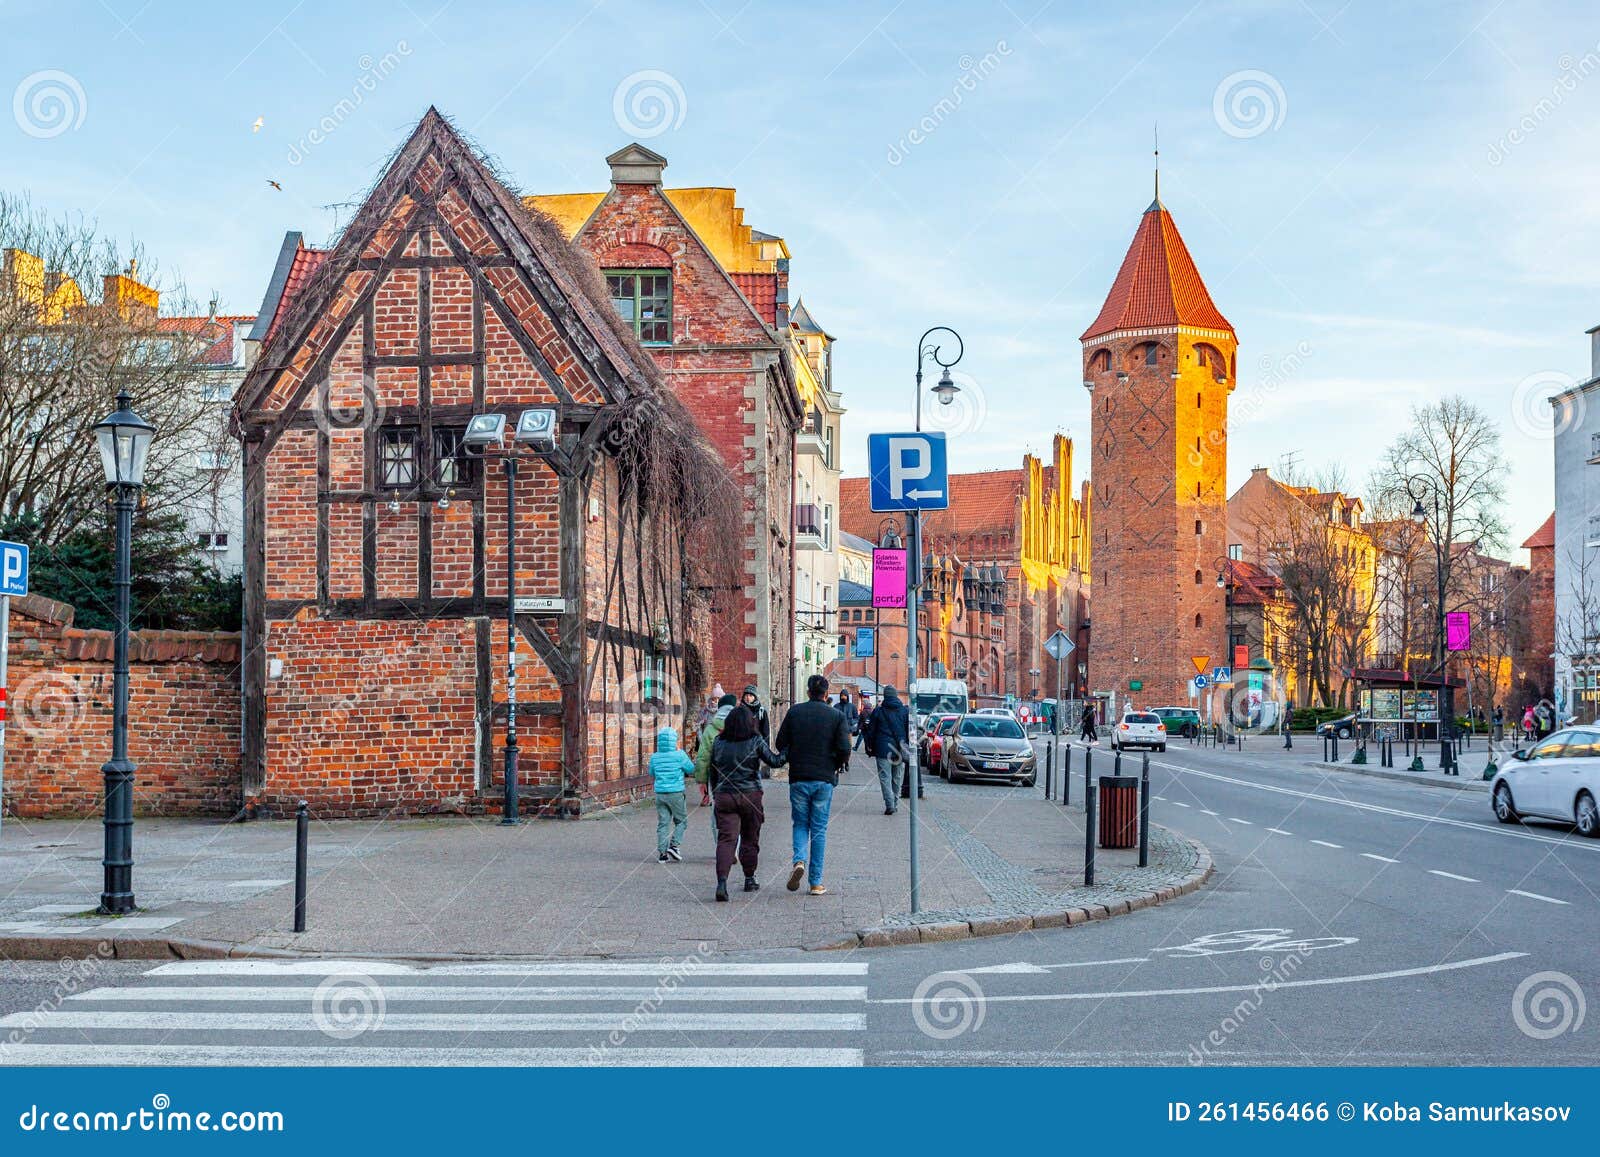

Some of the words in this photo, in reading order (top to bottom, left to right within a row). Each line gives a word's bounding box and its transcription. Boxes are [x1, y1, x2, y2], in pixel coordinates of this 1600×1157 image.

[889, 438, 931, 499] P
[4, 548, 22, 589] P
[875, 594, 905, 603] gcrt.pl
